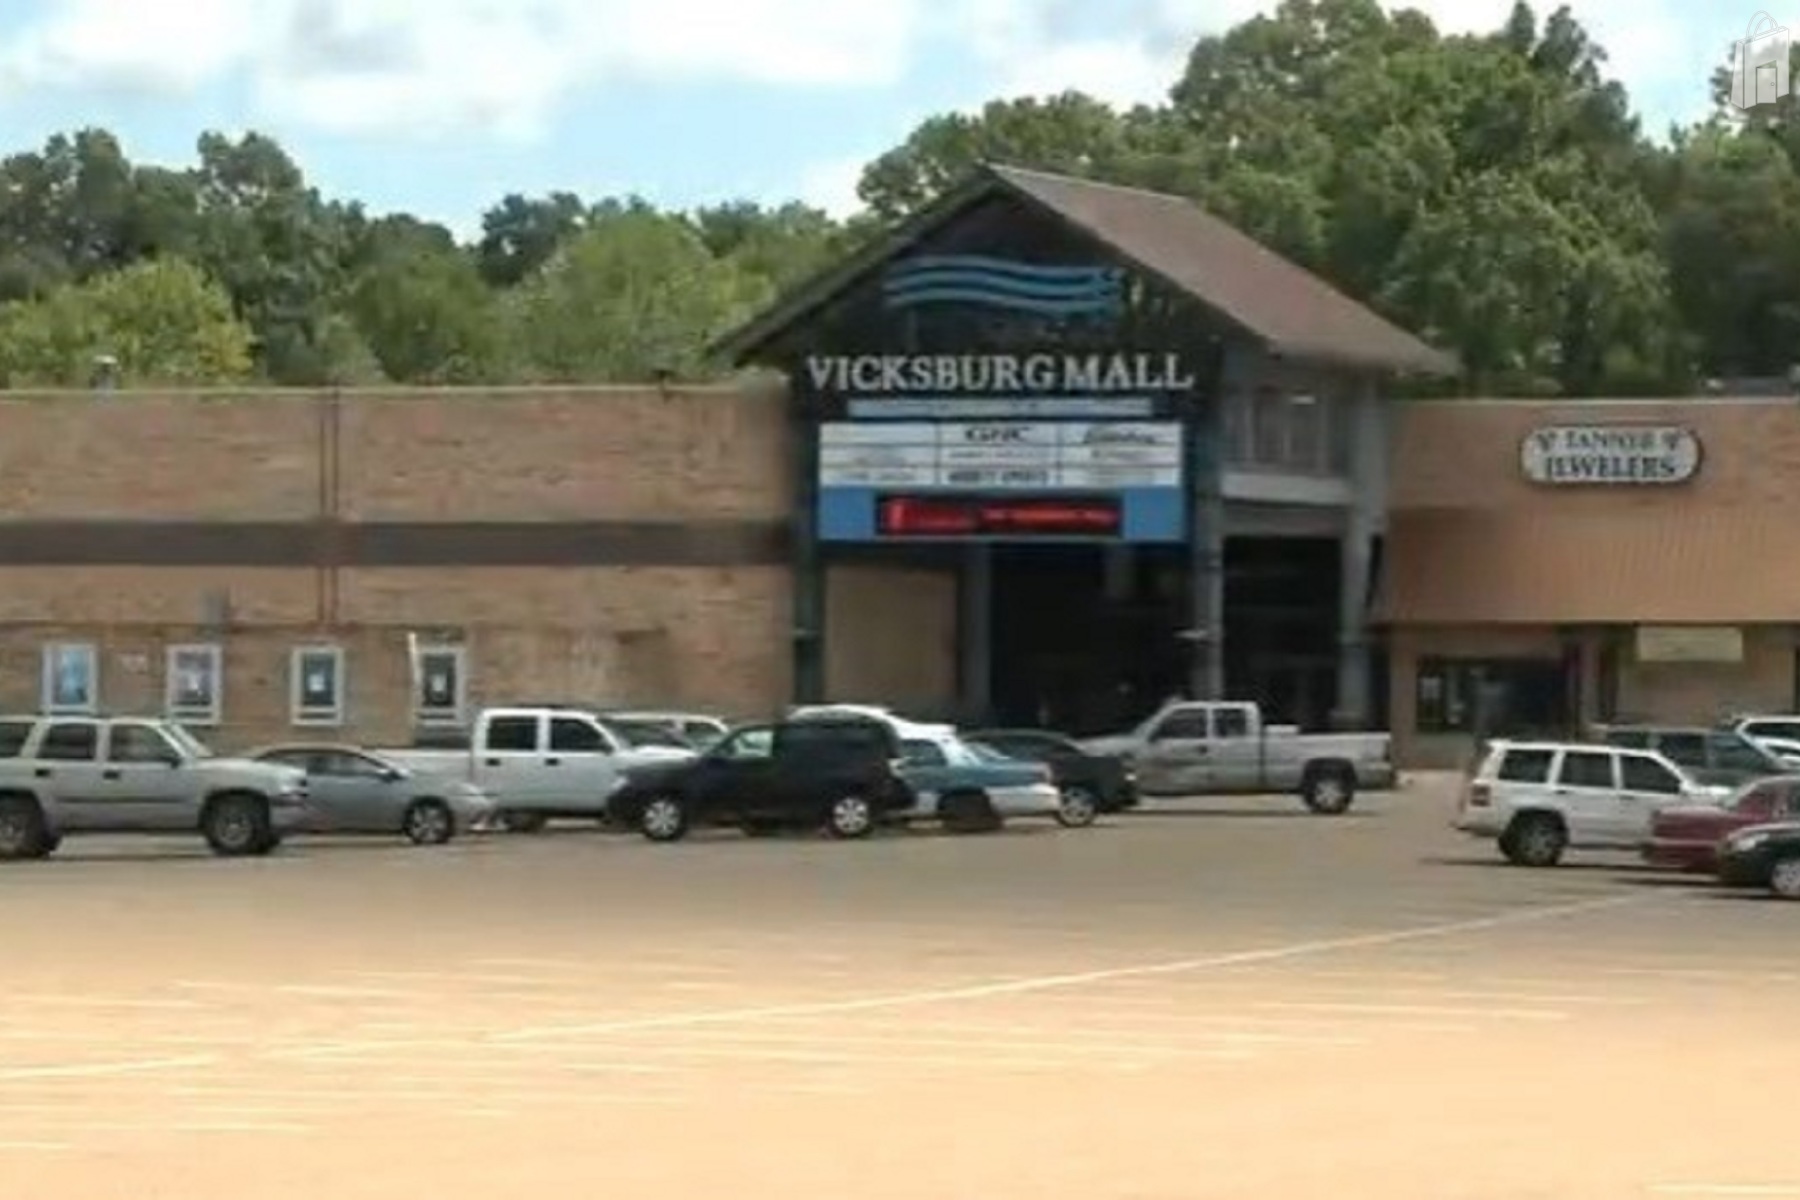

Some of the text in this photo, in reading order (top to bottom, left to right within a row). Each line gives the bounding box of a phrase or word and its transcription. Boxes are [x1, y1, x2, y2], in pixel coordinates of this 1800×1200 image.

[807, 353, 1195, 391] VICKSBURG MALL
[1546, 456, 1676, 478] JEWELERS
